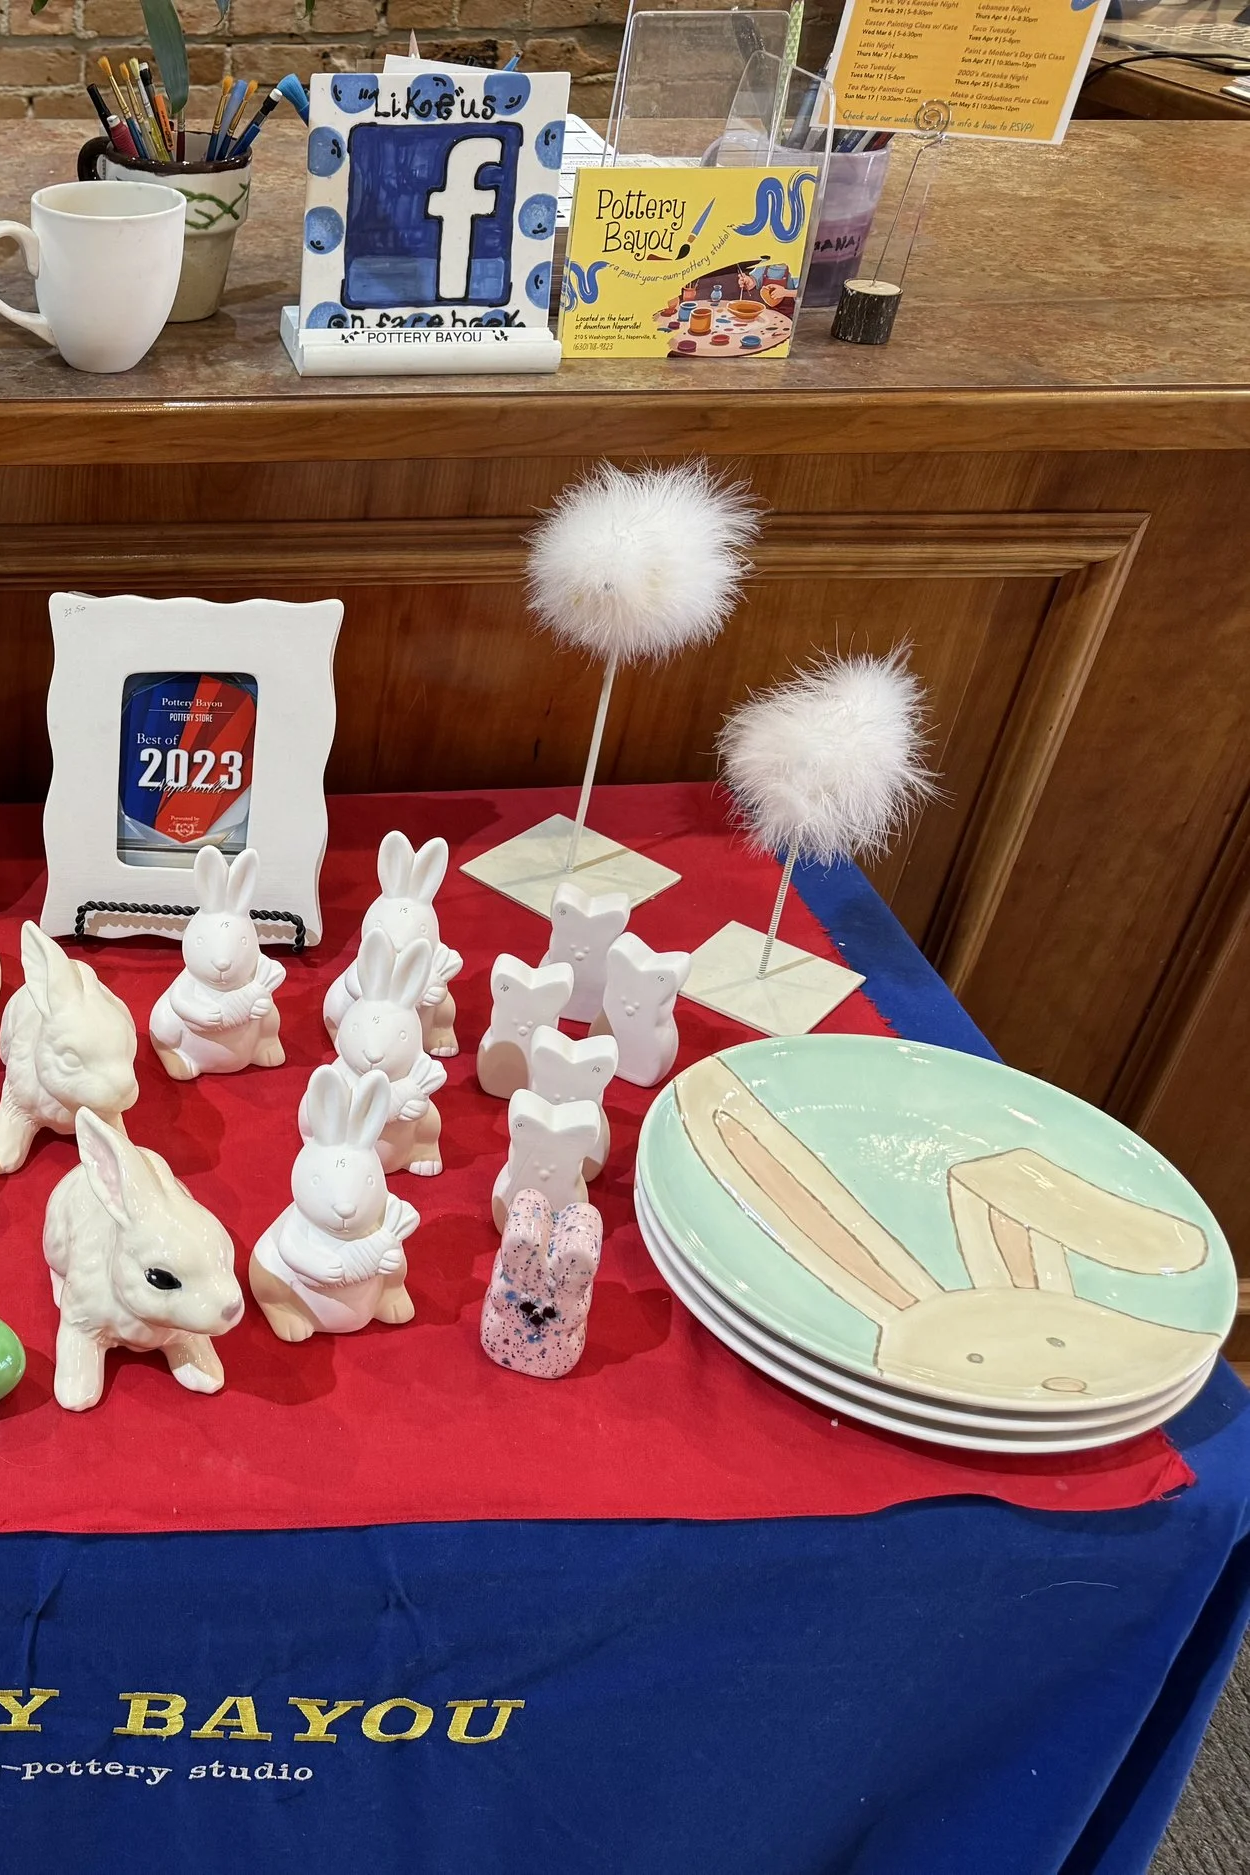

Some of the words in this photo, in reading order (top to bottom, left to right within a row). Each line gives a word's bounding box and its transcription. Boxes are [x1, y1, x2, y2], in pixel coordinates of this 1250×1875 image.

[596, 189, 687, 231] Pottery
[602, 221, 675, 262] Bayou
[575, 322, 583, 330] of
[583, 322, 611, 330] downtown
[576, 314, 599, 322] Located
[607, 314, 616, 322] the
[618, 314, 634, 322] heart
[367, 332, 431, 344] POTTERY
[435, 331, 483, 343] BAYOU
[162, 697, 194, 709] Pottery
[195, 698, 223, 709] Bayou
[169, 713, 194, 722] POTTERY
[195, 713, 213, 723] STORE
[137, 733, 163, 745] Best
[165, 733, 180, 746] of
[137, 747, 244, 790] 2023
[150, 777, 228, 797] Naperville
[112, 1691, 526, 1744] BAYOU
[189, 1760, 314, 1782] studio
